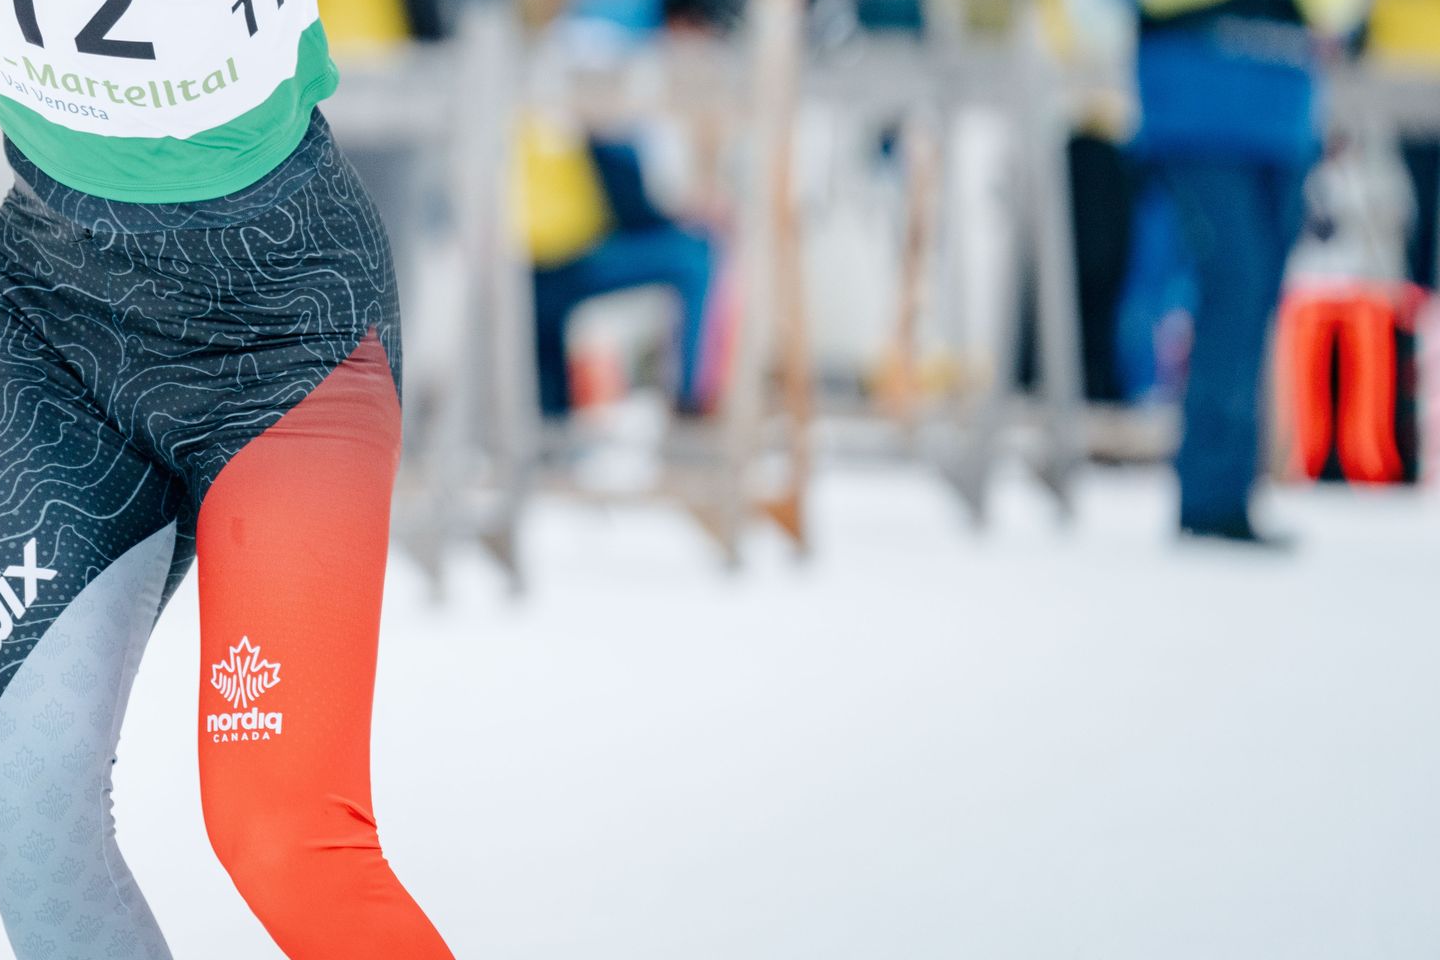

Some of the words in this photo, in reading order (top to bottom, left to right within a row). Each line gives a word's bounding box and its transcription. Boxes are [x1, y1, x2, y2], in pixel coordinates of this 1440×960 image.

[1, 71, 29, 95] Val
[30, 86, 109, 120] Venosta
[22, 56, 239, 109] Martelltal
[207, 706, 283, 734] nordiq
[213, 731, 271, 743] CANADA
